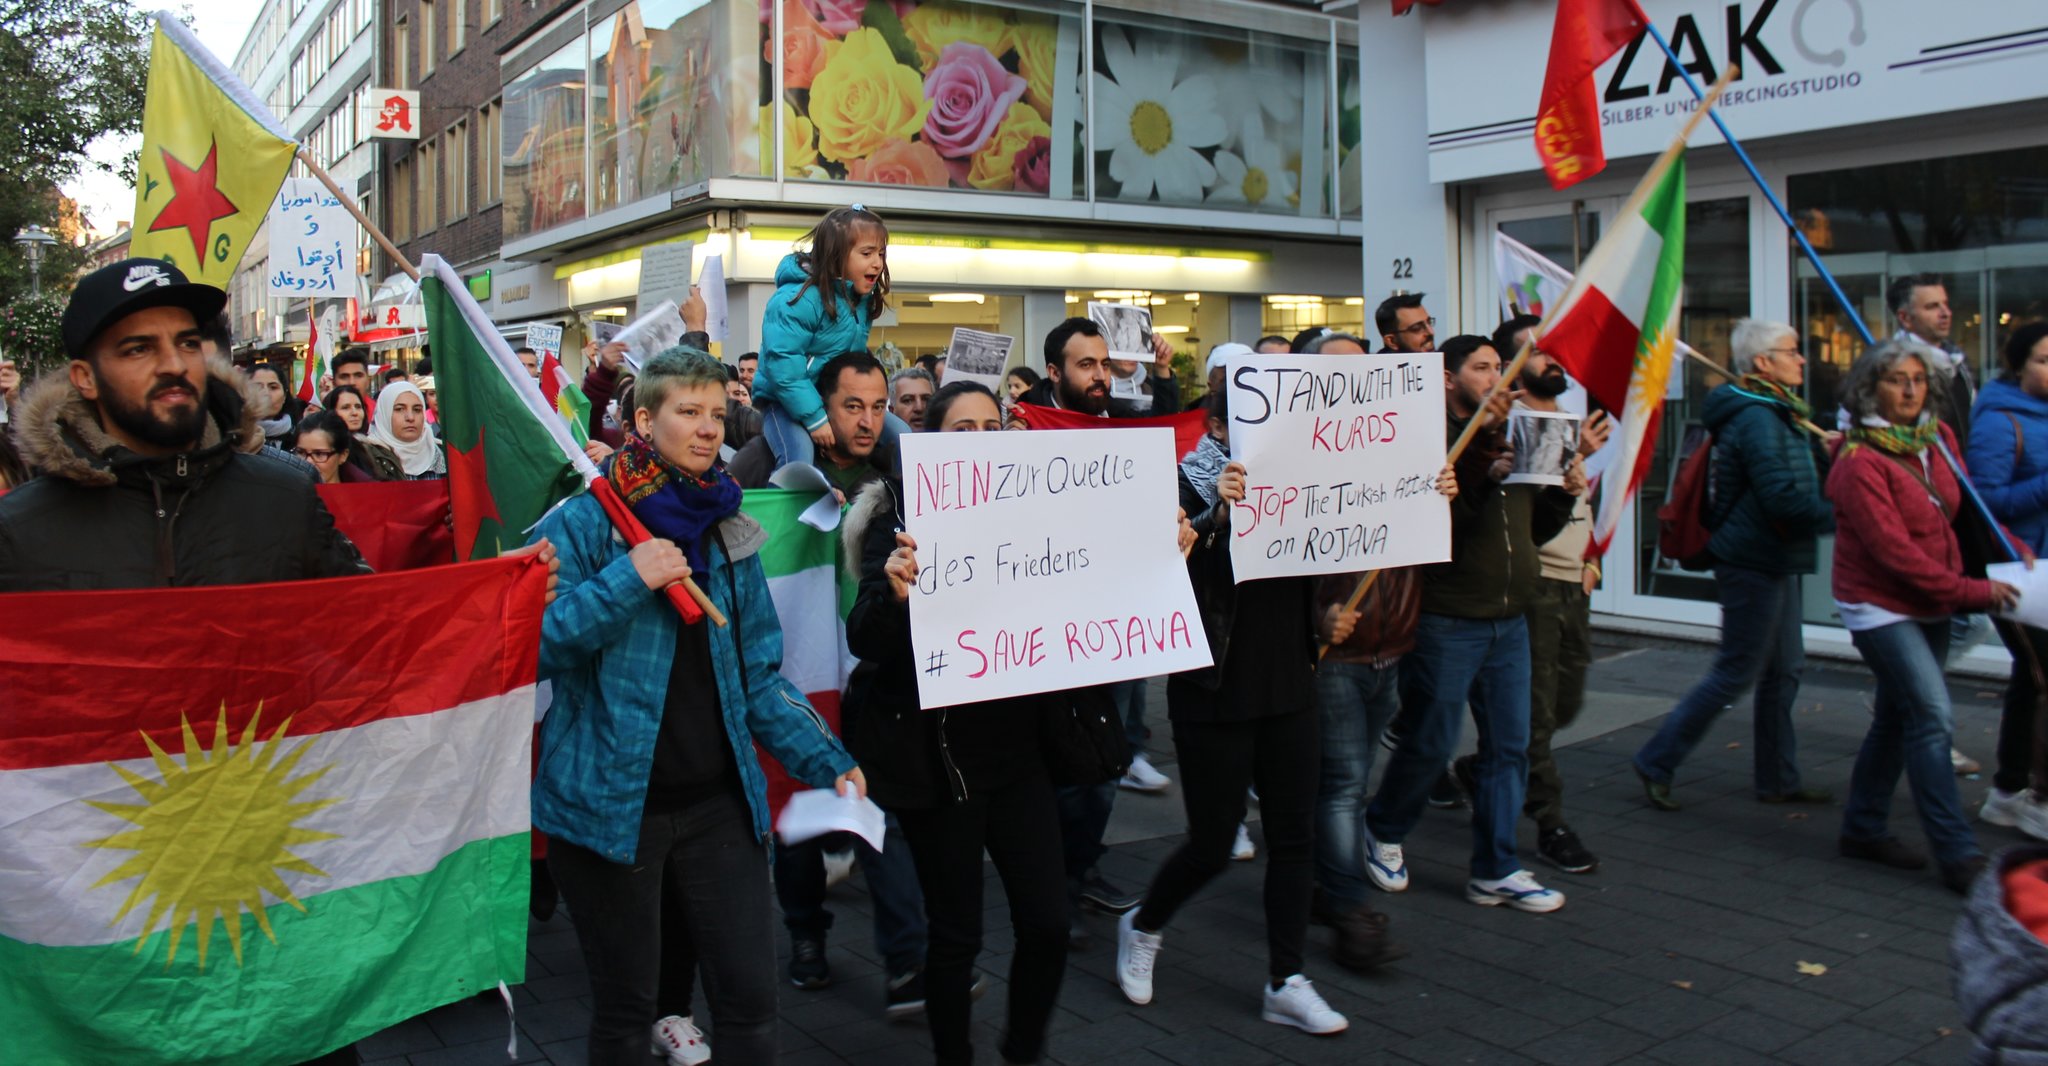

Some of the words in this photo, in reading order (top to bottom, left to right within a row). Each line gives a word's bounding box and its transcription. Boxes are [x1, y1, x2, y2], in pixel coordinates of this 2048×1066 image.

[129, 265, 160, 280] NIKE
[1393, 257, 1413, 279] 22
[1233, 366, 1346, 424] STAND
[1350, 368, 1393, 404] WITH
[1397, 362, 1424, 395] THE
[1312, 412, 1399, 452] KURDS
[915, 460, 991, 517] NEIN
[1046, 454, 1135, 494] Quelle
[1234, 486, 1299, 538] STOP
[1301, 484, 1330, 518] The
[1329, 482, 1387, 515] Turkish
[918, 542, 976, 595] des
[996, 537, 1090, 584] Friedens
[1266, 536, 1295, 559] on
[1302, 523, 1388, 563] ROJAVA
[957, 627, 1046, 679] SAVE
[1064, 611, 1192, 662] ROJAVA
